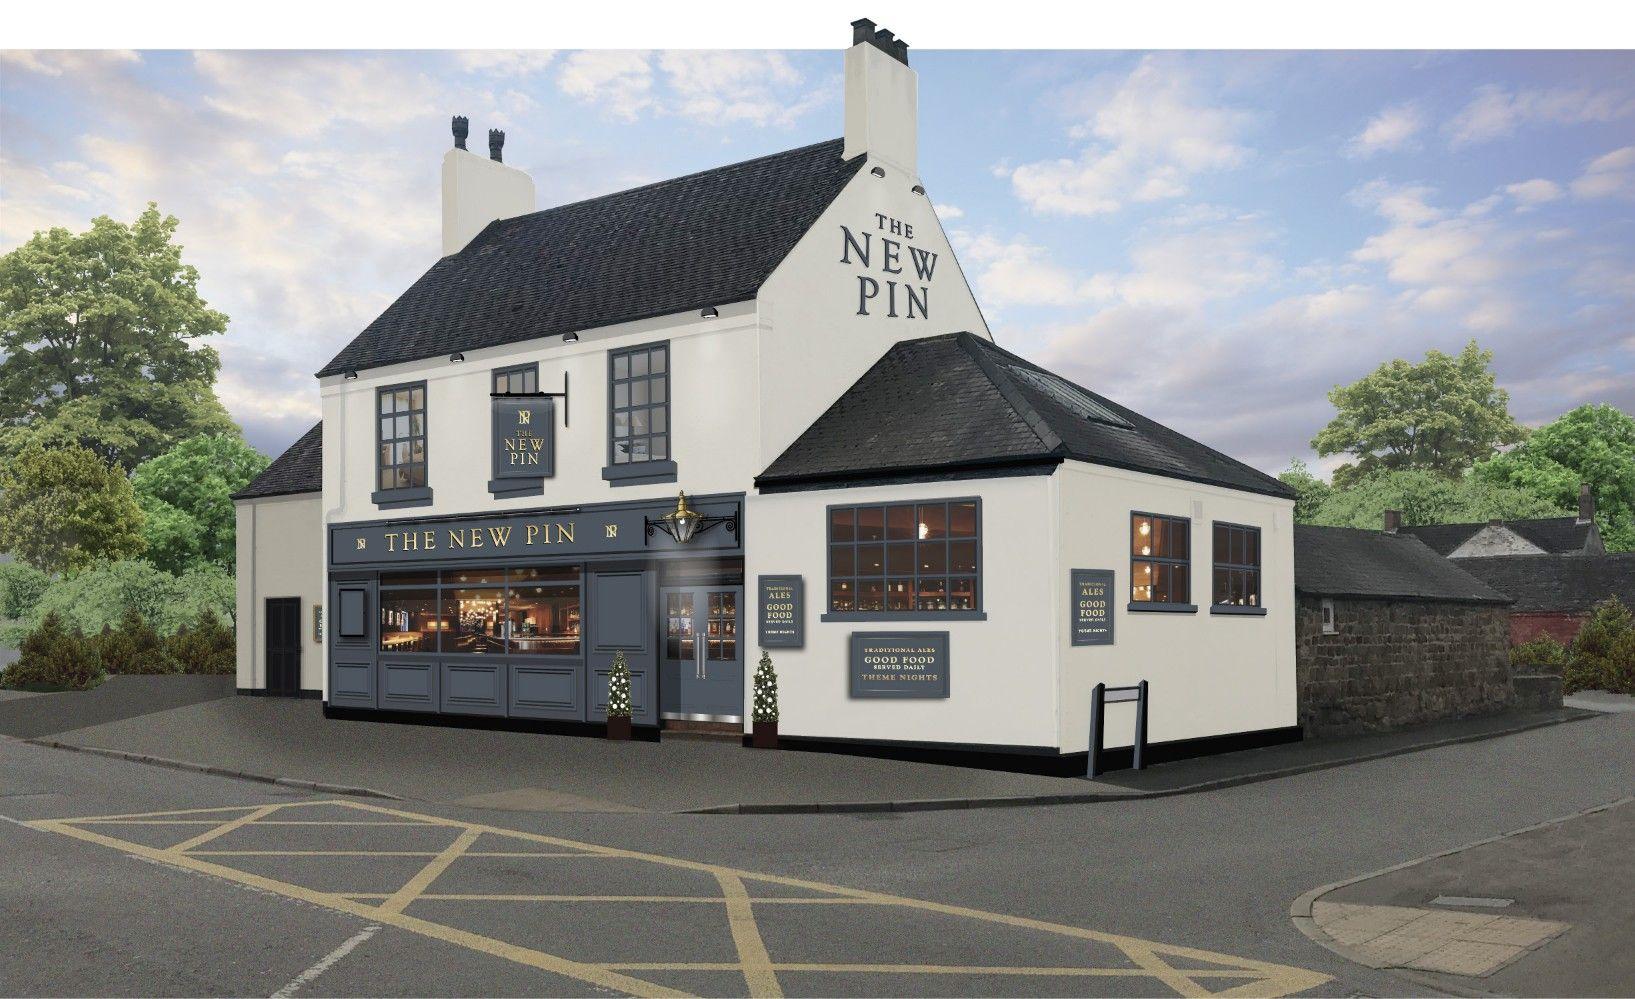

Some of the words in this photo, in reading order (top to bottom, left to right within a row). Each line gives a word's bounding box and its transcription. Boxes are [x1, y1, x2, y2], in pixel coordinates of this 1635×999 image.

[875, 212, 914, 240] THE
[840, 225, 938, 282] NEW
[856, 275, 929, 320] PIN
[504, 438, 544, 451] NEW
[510, 452, 538, 465] PIN
[384, 530, 436, 552] THE
[449, 526, 512, 549] NEW
[526, 522, 575, 545] PIN
[1081, 587, 1104, 596] ALES
[766, 603, 793, 611] GOOD
[1079, 600, 1106, 608] GOOD
[767, 611, 793, 619] FOOD
[1080, 609, 1105, 617] FOOD
[864, 656, 898, 664] GOOD
[902, 656, 935, 664] FOOD
